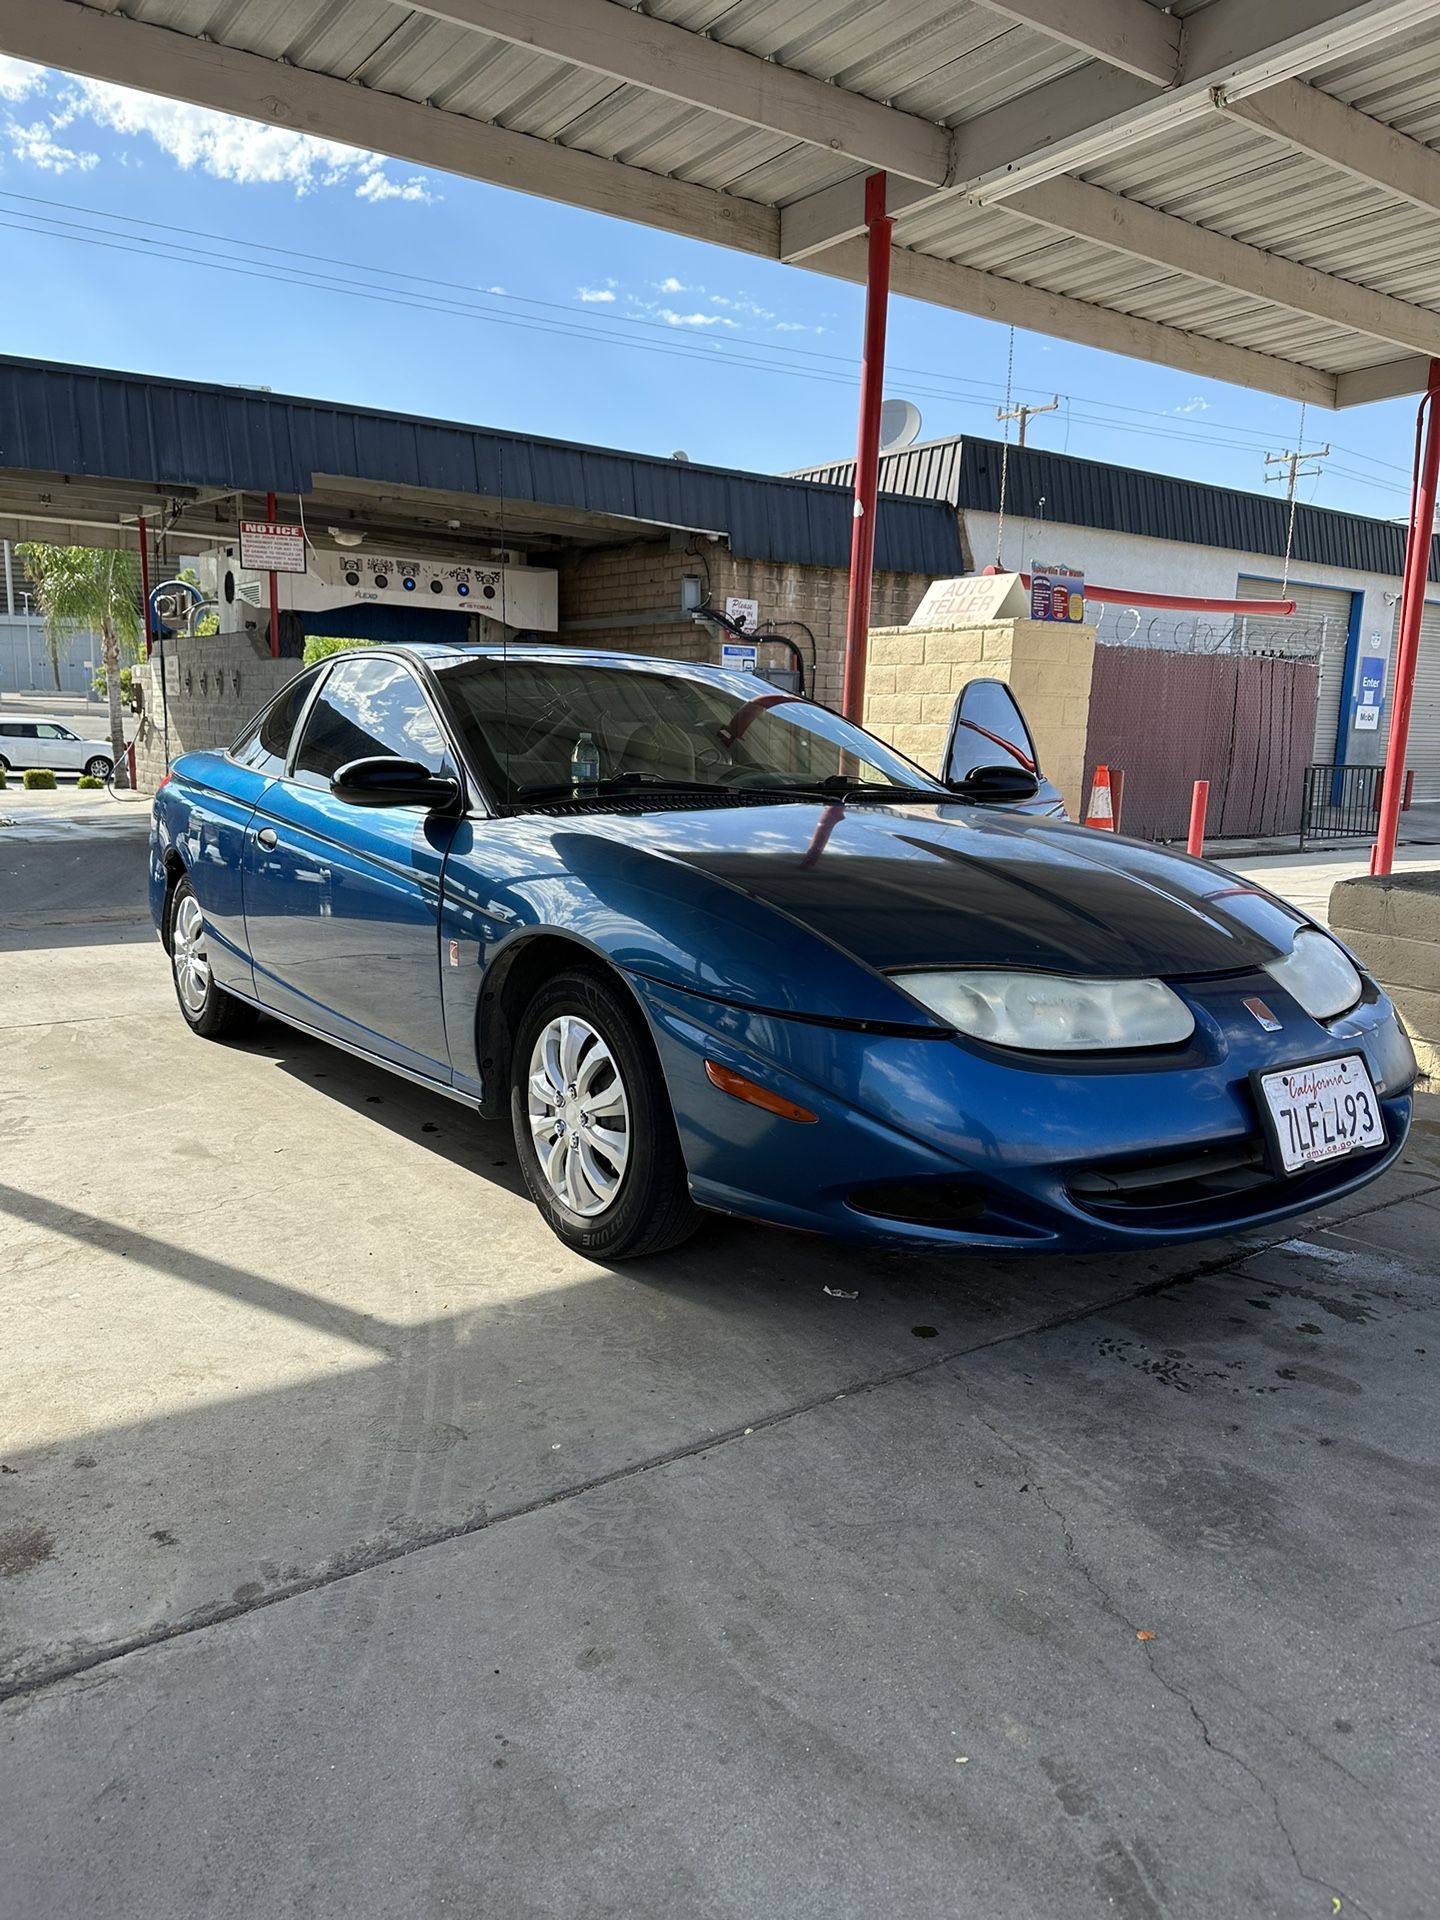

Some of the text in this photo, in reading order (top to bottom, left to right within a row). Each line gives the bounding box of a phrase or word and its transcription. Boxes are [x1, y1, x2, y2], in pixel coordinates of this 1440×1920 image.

[246, 524, 299, 535] NOTICE
[942, 578, 995, 597] AUTO
[731, 599, 753, 610] Please
[926, 596, 995, 615] TELLER
[1362, 676, 1380, 688] Enter
[1288, 1073, 1351, 1100] California
[1280, 1091, 1375, 1154] 7LFL493
[1306, 1138, 1358, 1159] dmv.ca.gov
